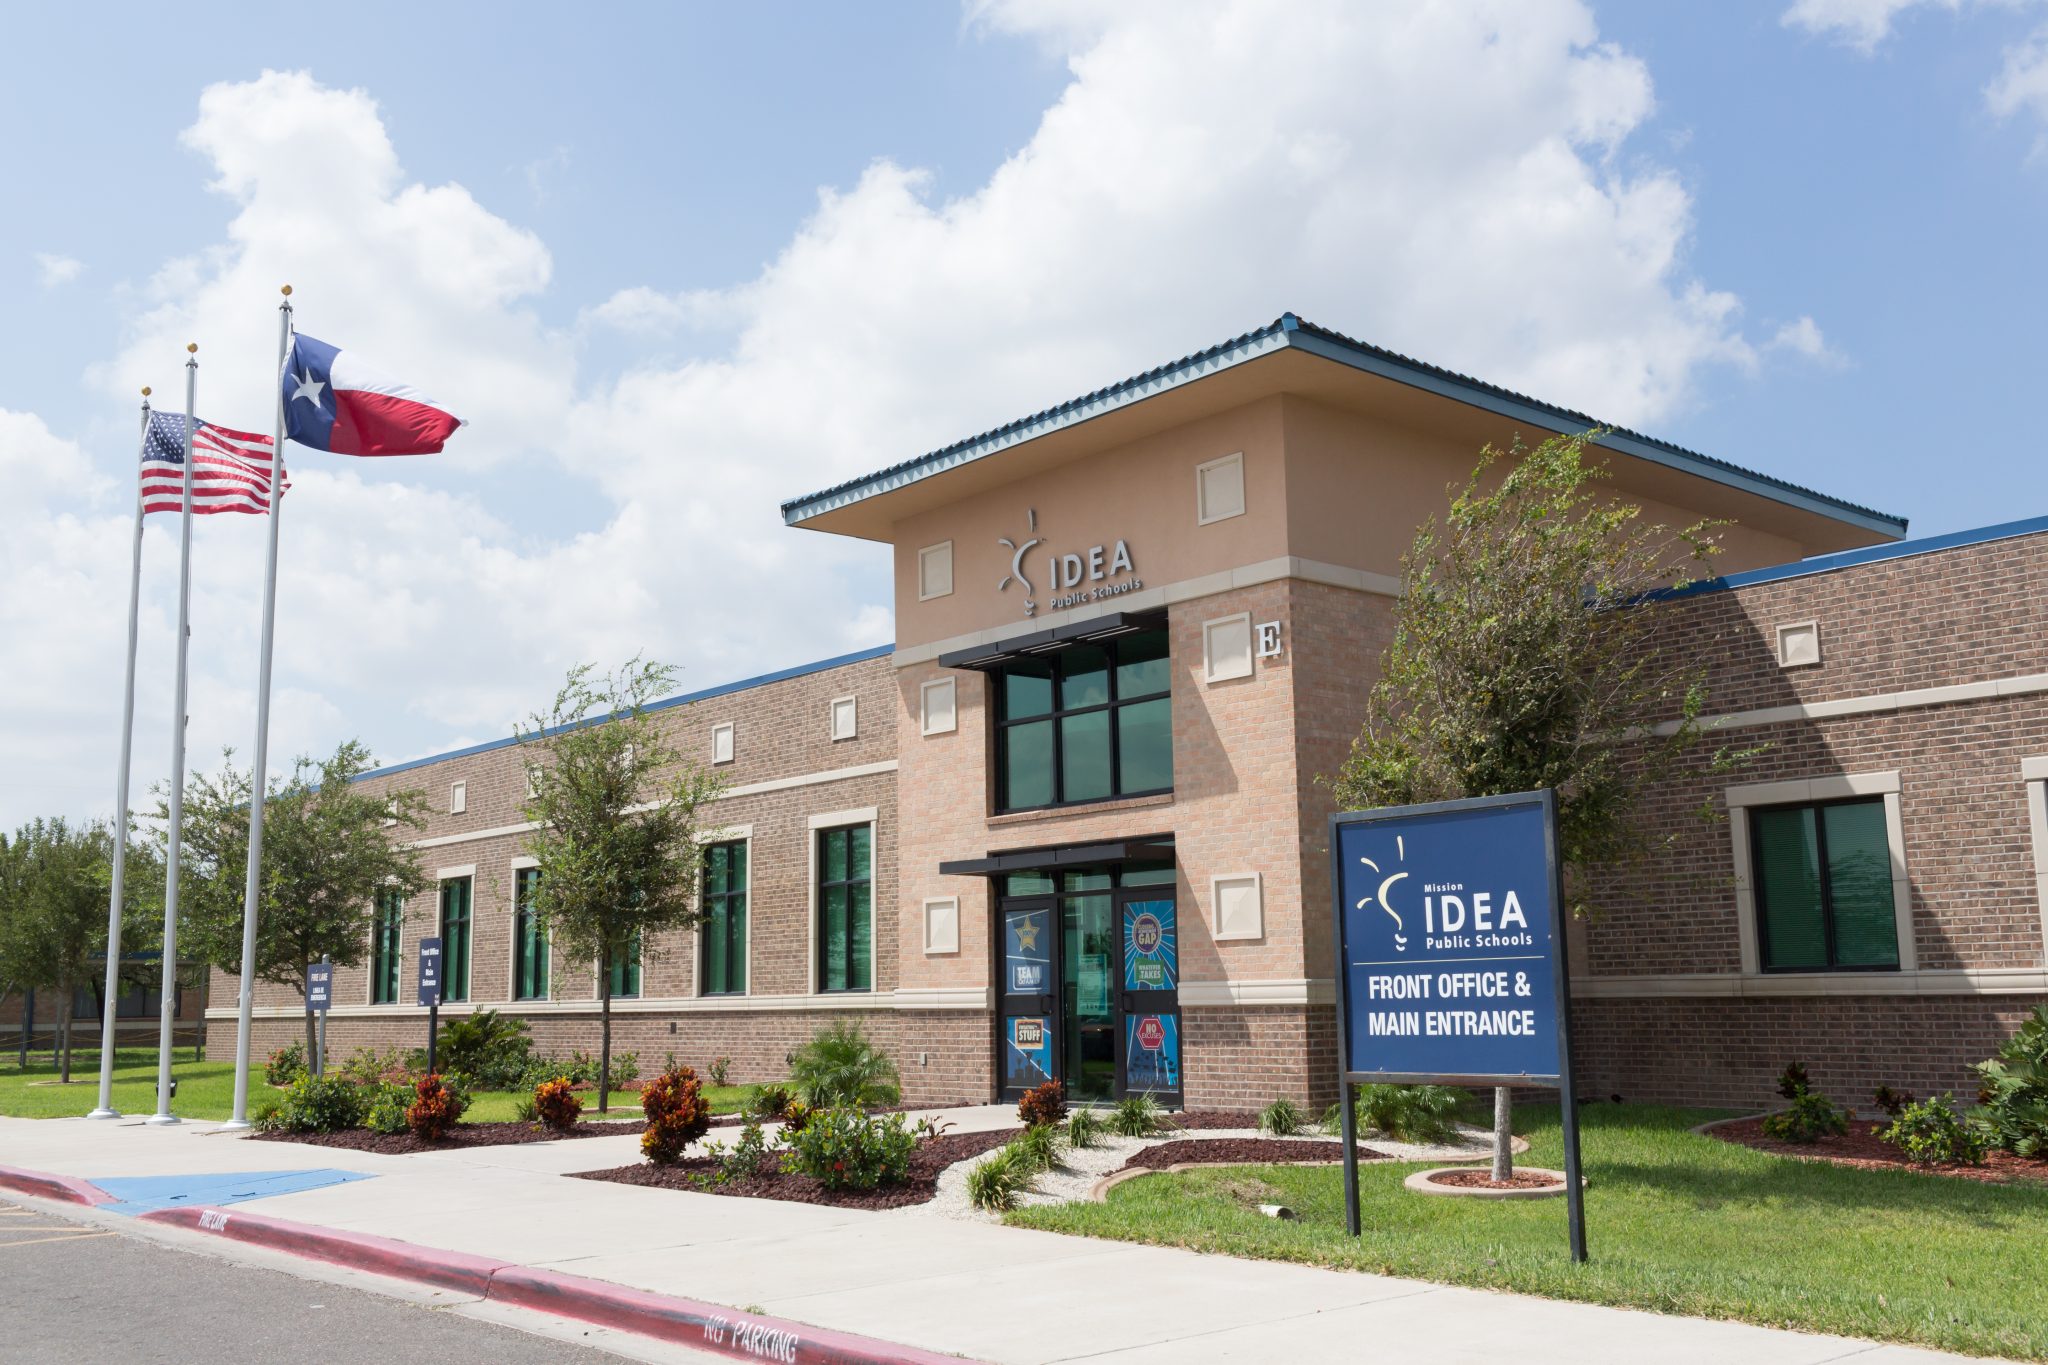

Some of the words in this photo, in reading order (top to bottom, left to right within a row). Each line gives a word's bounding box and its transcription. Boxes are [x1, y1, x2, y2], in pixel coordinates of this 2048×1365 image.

[1050, 539, 1133, 590] IDEA
[1050, 591, 1087, 610] Public
[1091, 577, 1142, 599] Schools
[1254, 620, 1281, 659] E
[1424, 882, 1463, 893] Mission
[1424, 890, 1528, 933] IDEA
[1138, 932, 1157, 945] GAP
[1426, 934, 1471, 950] Public
[1475, 932, 1533, 947] Schools
[1017, 966, 1041, 979] TEAM
[1140, 970, 1161, 979] TAKES
[1368, 974, 1432, 1000] FRONT
[1437, 972, 1509, 998] OFFICE
[1514, 971, 1532, 997] &
[1145, 1023, 1157, 1033] NO
[1368, 1011, 1420, 1036] MAIN
[1425, 1010, 1536, 1036] ENTRANCE
[1018, 1029, 1041, 1041] STUFF
[703, 1314, 728, 1344] NO
[731, 1320, 799, 1364] PARKING
